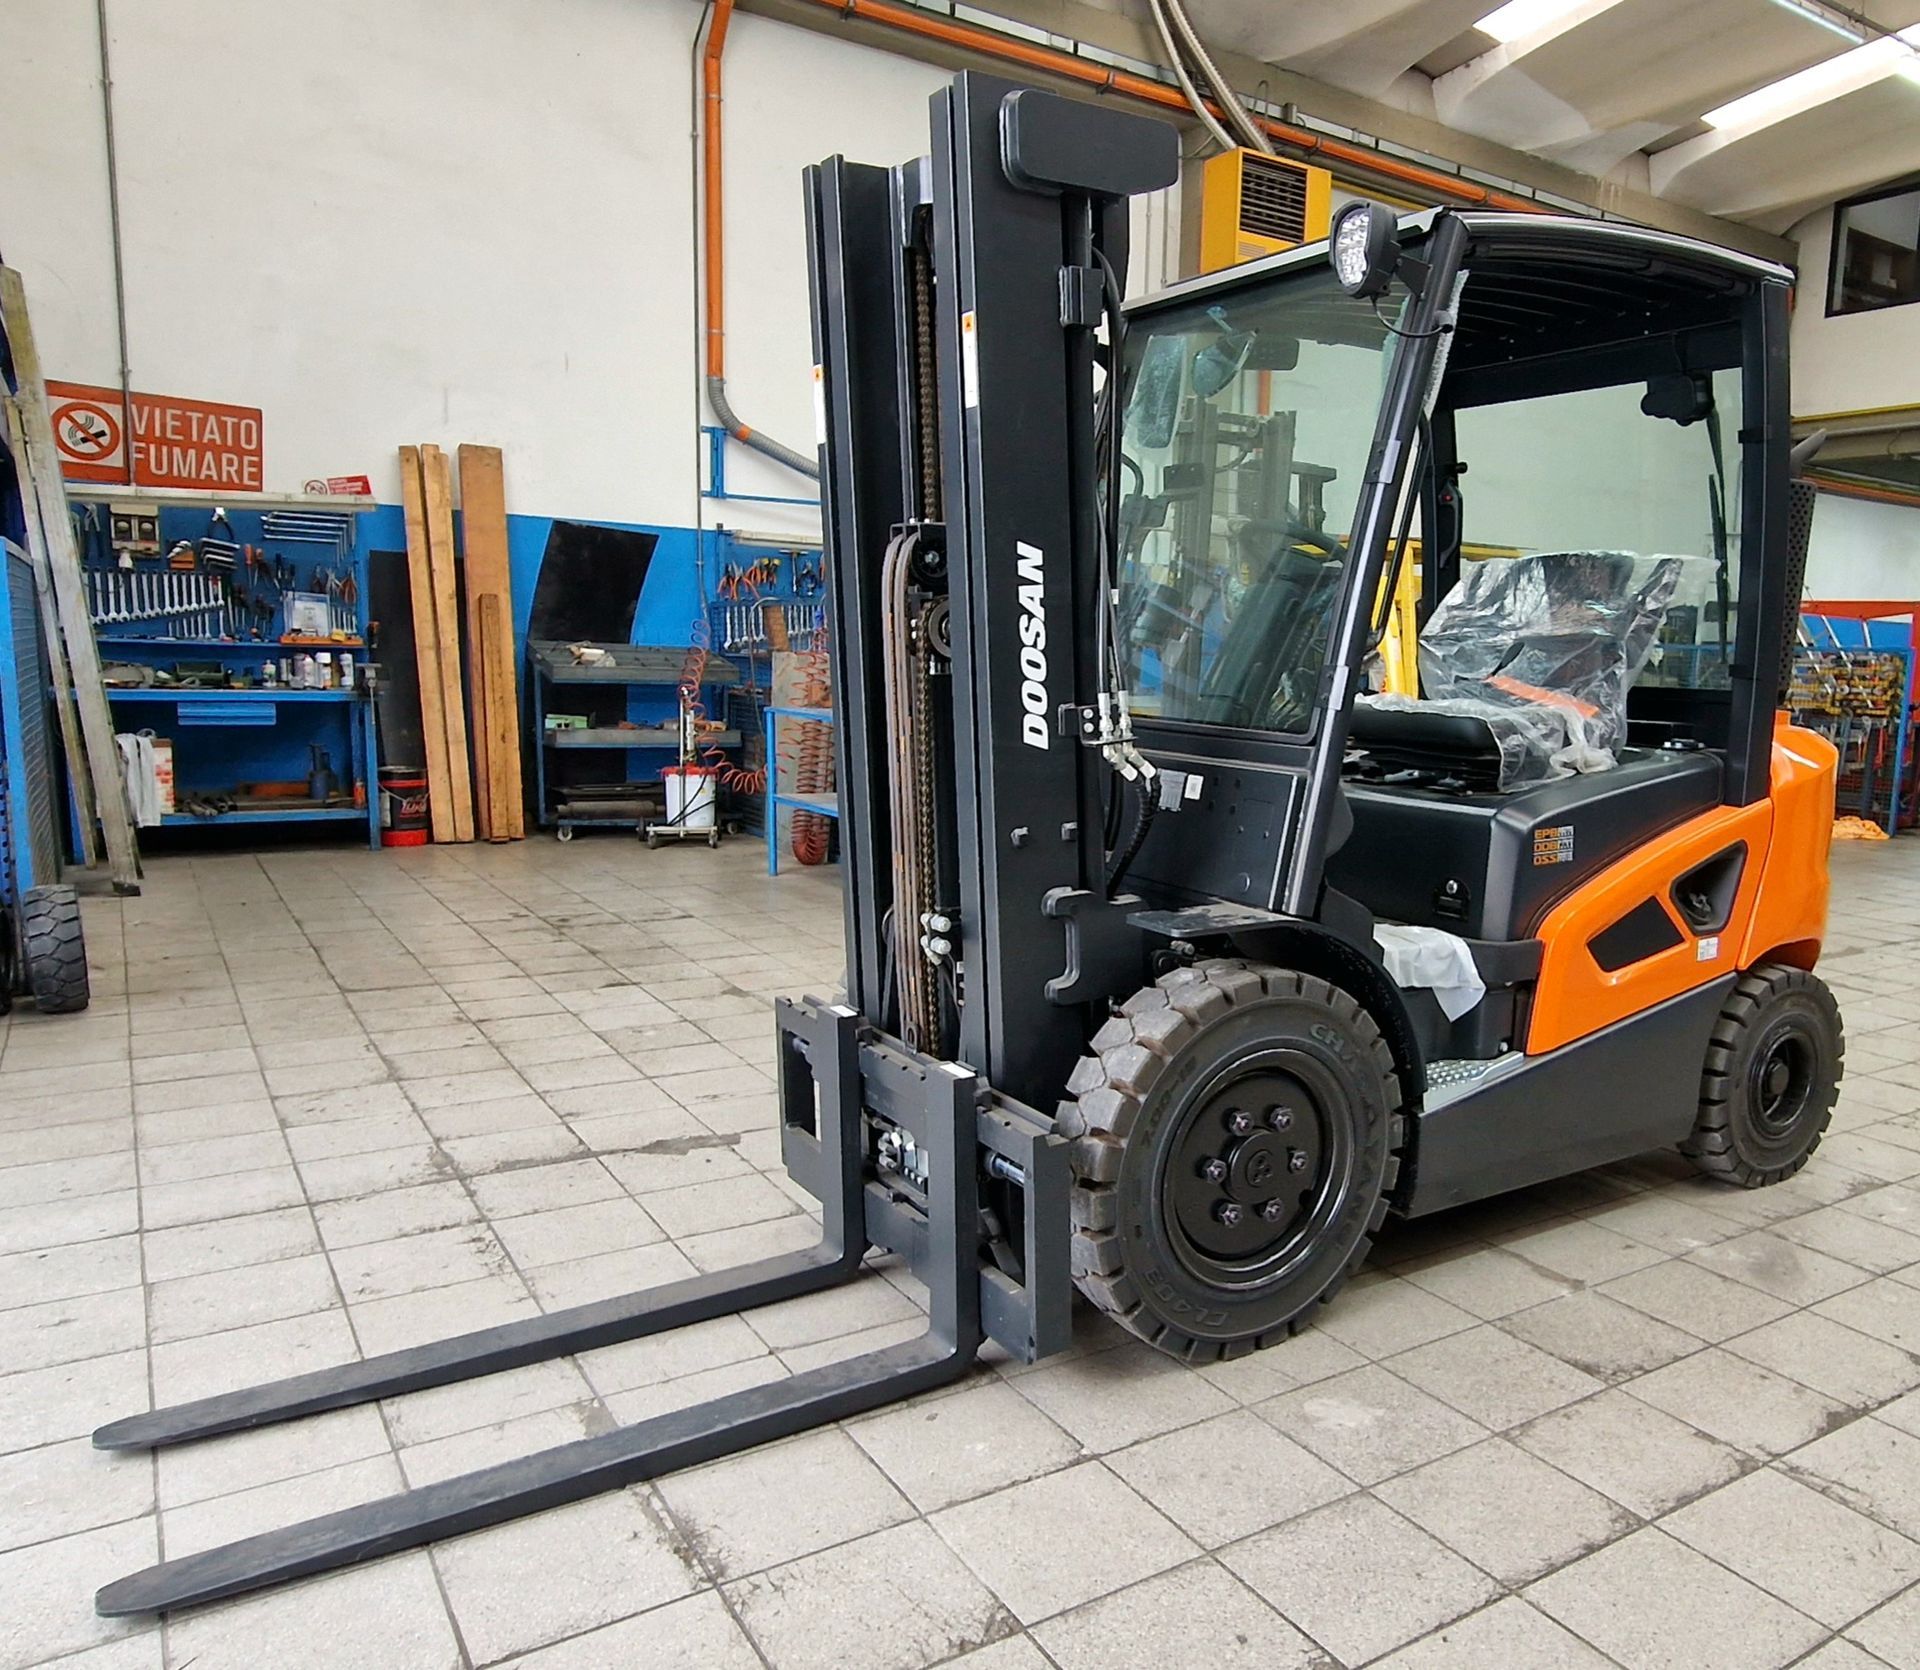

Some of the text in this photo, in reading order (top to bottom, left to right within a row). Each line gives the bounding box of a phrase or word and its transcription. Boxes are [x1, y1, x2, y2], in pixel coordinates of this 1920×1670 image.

[131, 404, 257, 450] VIETATO
[131, 441, 260, 486] FUMARE
[1017, 541, 1049, 750] DOOSAN
